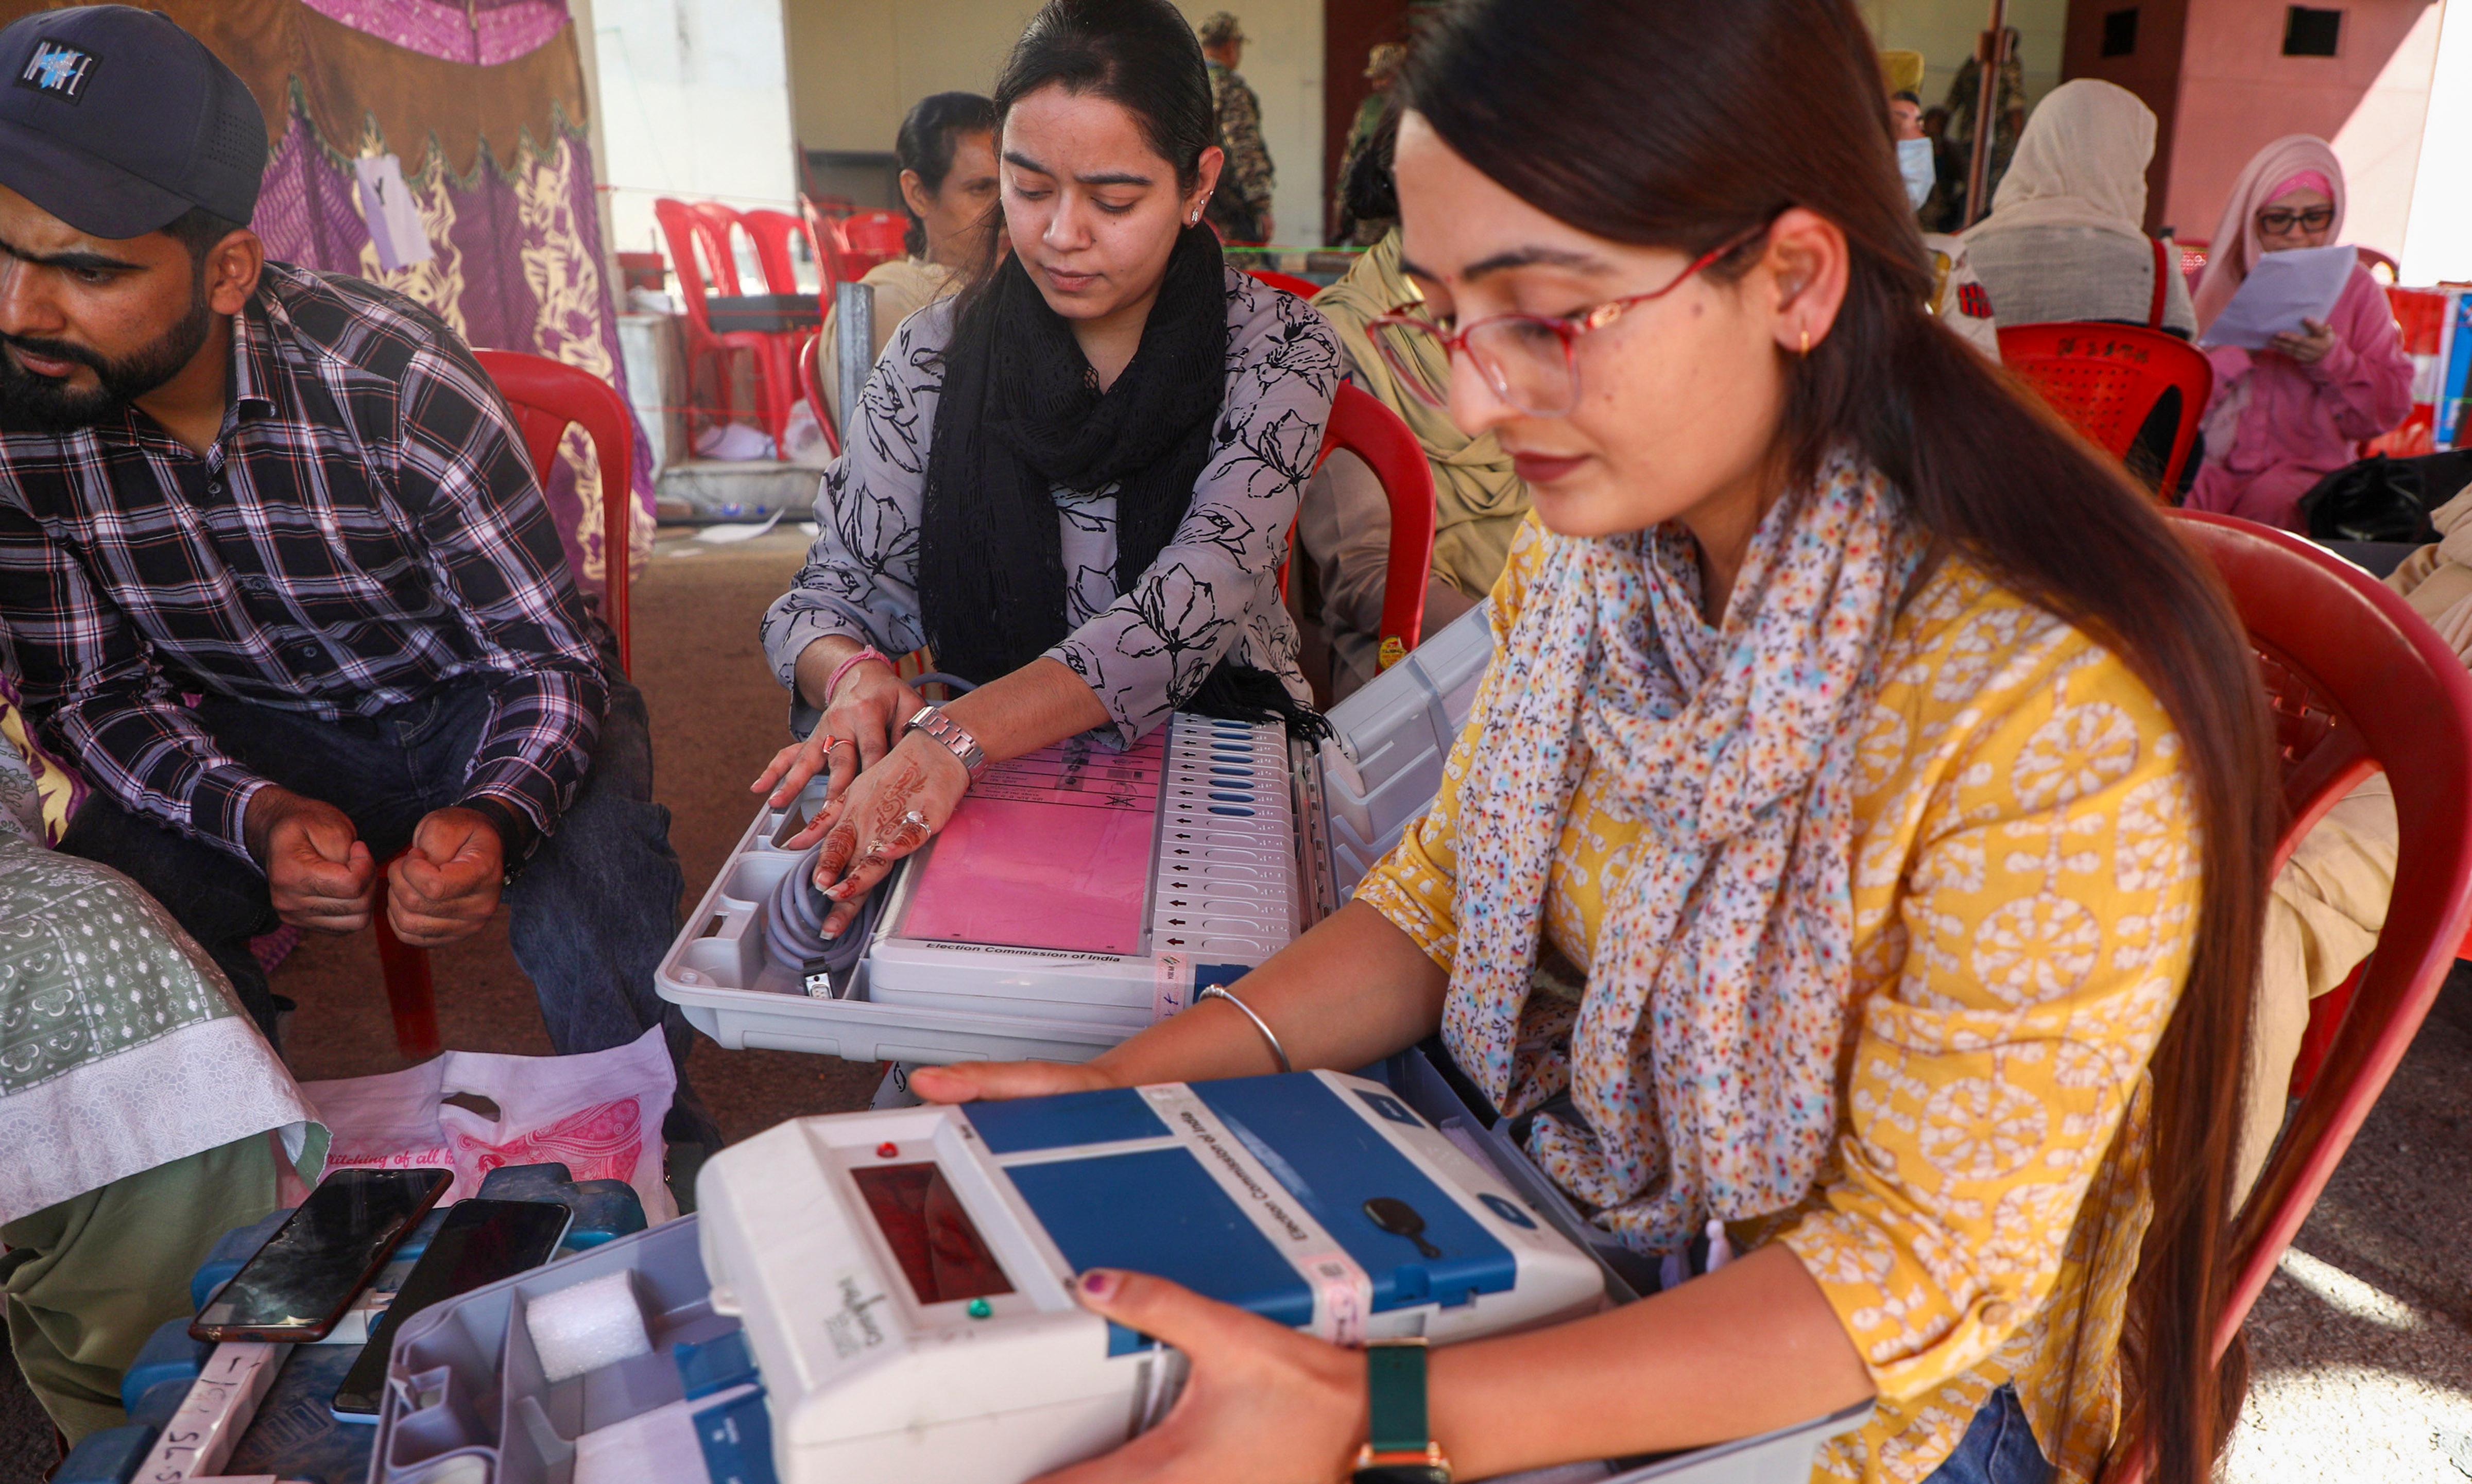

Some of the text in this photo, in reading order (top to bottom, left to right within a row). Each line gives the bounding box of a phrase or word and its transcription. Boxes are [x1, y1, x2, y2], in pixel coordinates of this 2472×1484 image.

[926, 943, 981, 952] Election
[985, 946, 1068, 958] Commission
[1088, 954, 1121, 962] India
[1181, 1111, 1206, 1132] India
[393, 1150, 412, 1169] of
[416, 1148, 439, 1164] all
[1211, 1143, 1268, 1200] Commission
[1265, 1201, 1308, 1240] Election
